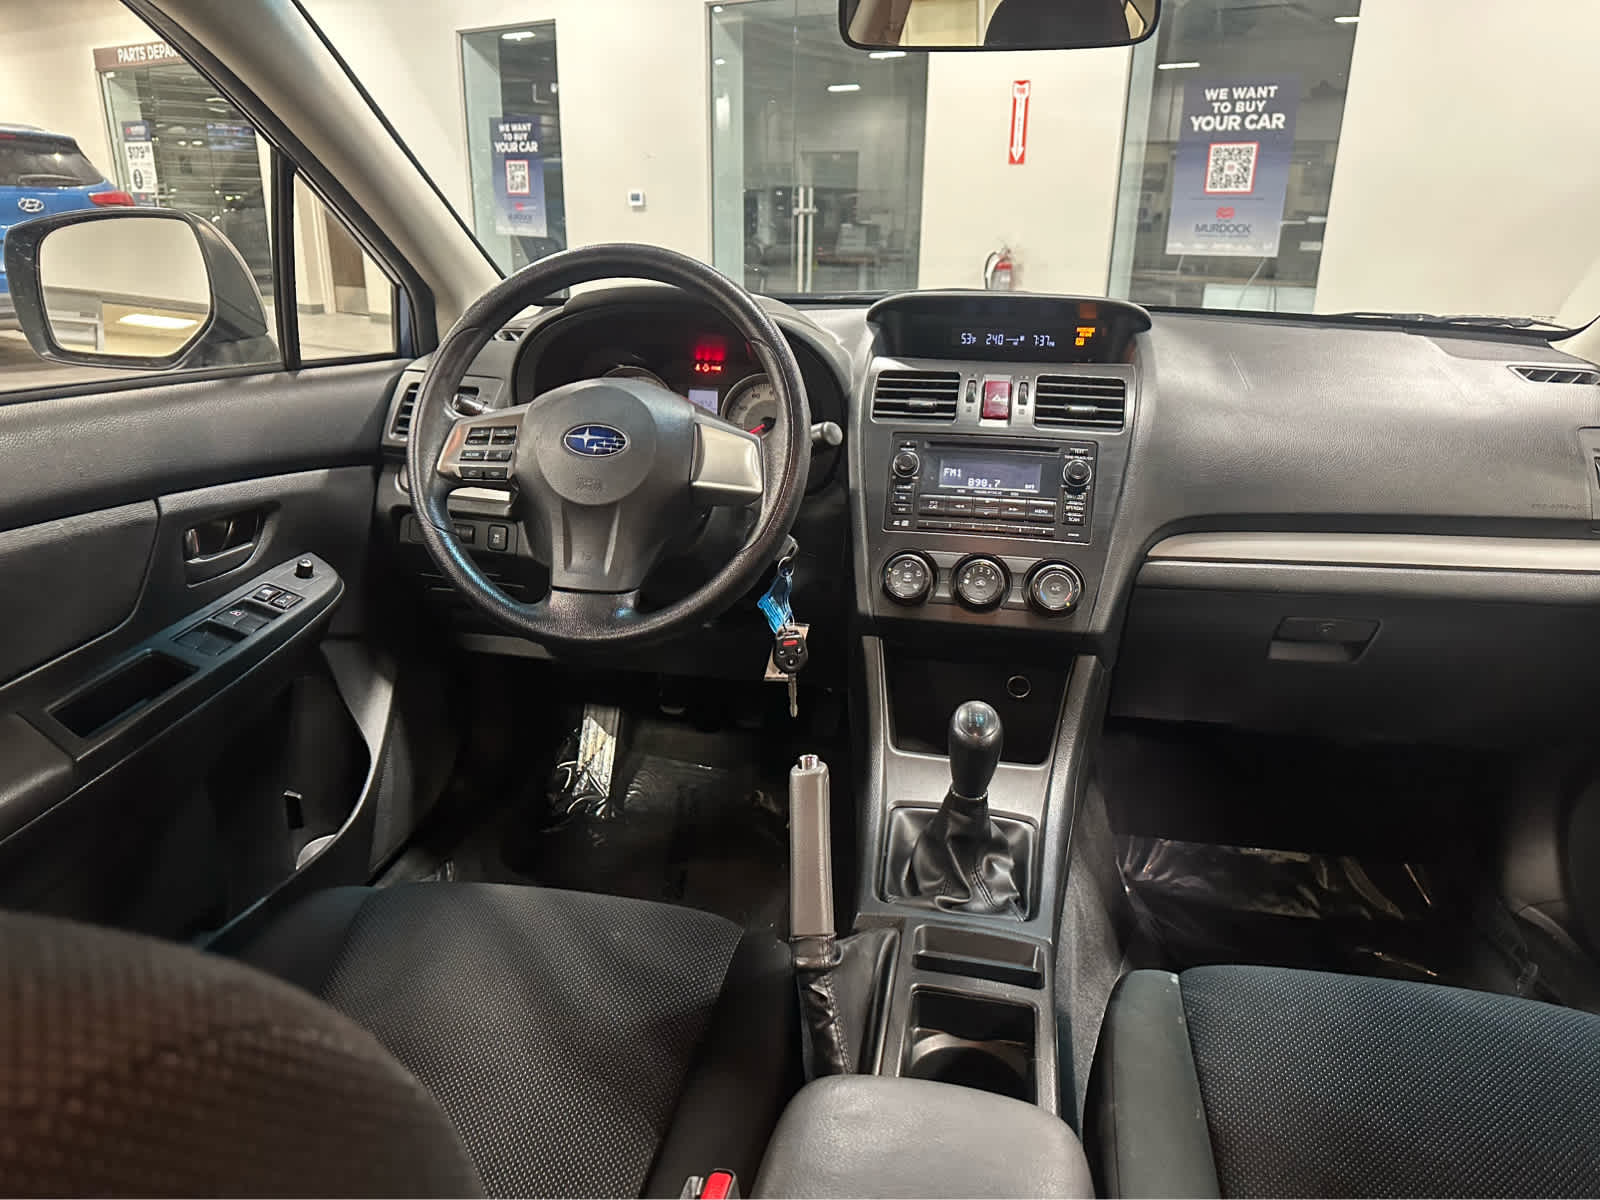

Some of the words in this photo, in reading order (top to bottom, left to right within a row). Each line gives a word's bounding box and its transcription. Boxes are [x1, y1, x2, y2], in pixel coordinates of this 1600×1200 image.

[117, 46, 146, 64] PARTS
[1205, 88, 1228, 101] WE
[1232, 85, 1278, 99] WANT
[1212, 102, 1231, 114] TO
[1235, 100, 1266, 113] BUY
[499, 124, 510, 132] WE
[511, 123, 532, 132] WANT
[1191, 115, 1241, 132] YOUR
[1244, 113, 1285, 130] CAR
[503, 133, 512, 141] TO
[513, 133, 528, 141] BUY
[494, 142, 518, 153] YOUR
[519, 141, 538, 153] CAR
[1194, 223, 1252, 233] MURDOCK
[985, 333, 1004, 345] 240
[943, 467, 962, 478] FM1
